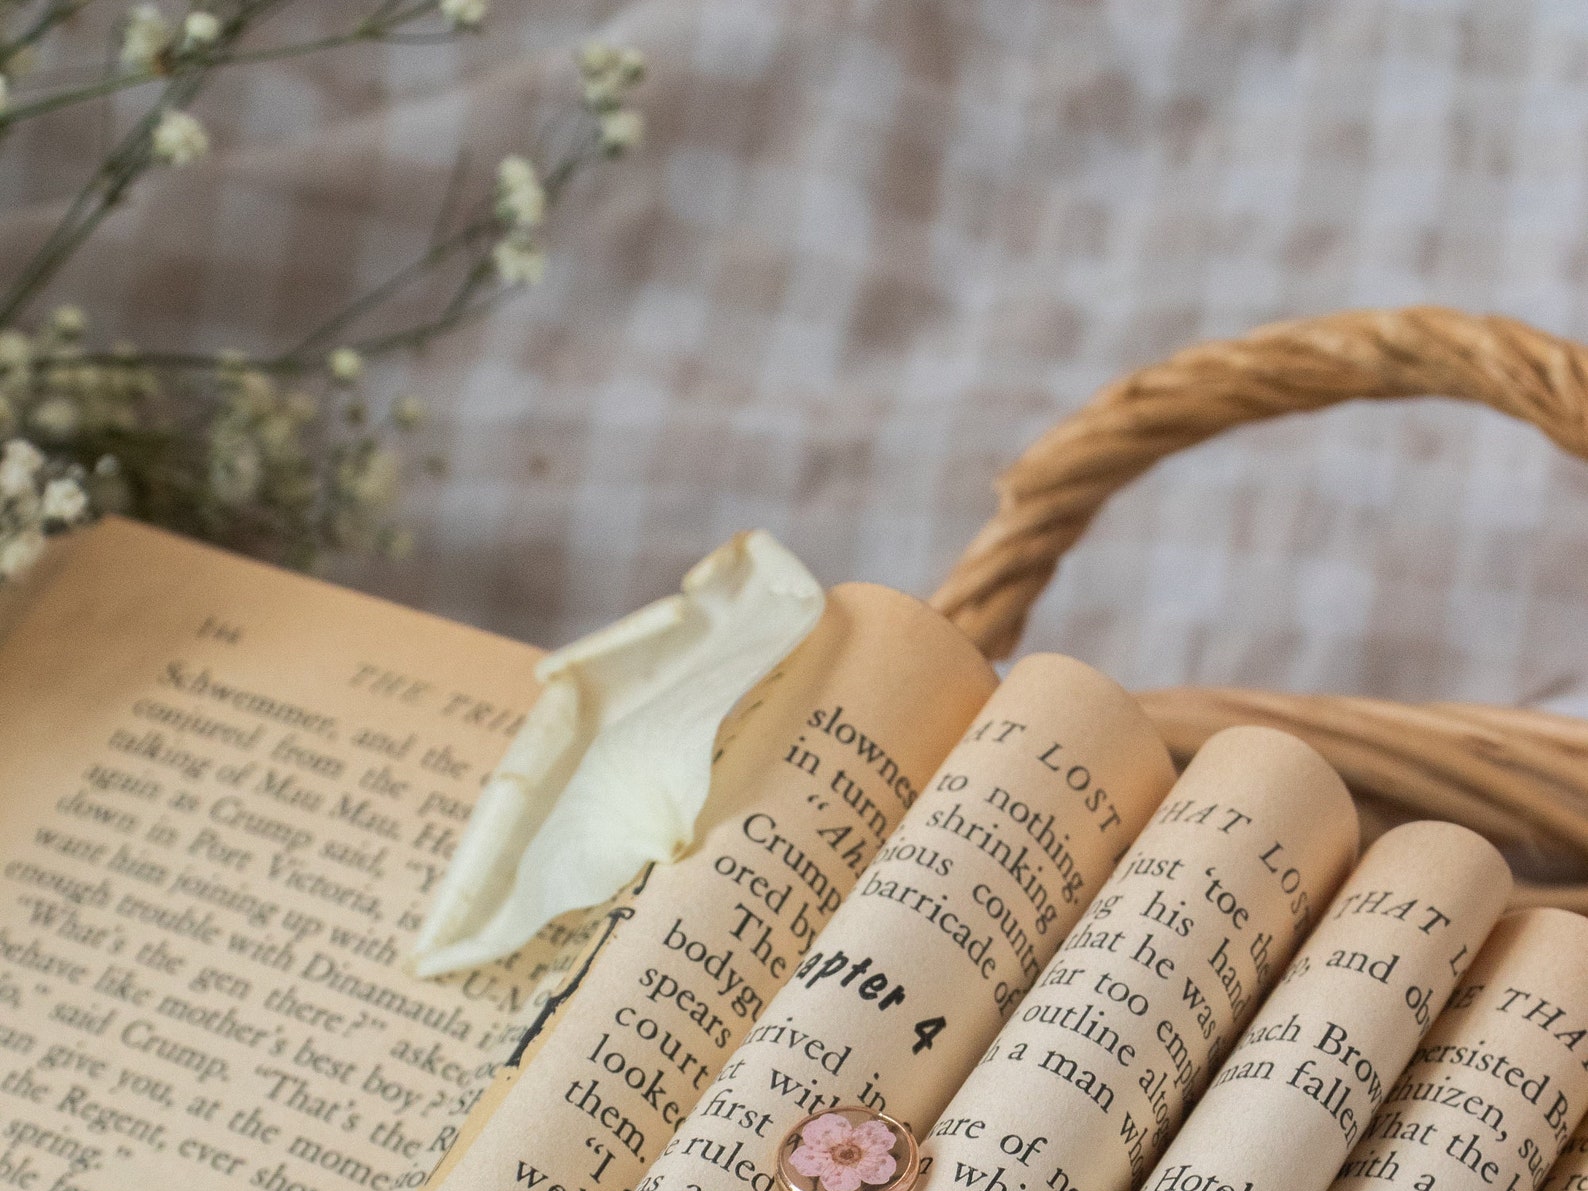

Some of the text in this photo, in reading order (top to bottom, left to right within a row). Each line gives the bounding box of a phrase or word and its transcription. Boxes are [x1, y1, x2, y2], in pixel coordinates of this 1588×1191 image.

[784, 736, 821, 776] in
[1037, 742, 1122, 832] LOST
[714, 856, 793, 915] ored
[743, 813, 841, 914] Crump
[926, 803, 1058, 935] shrinking
[116, 895, 221, 944] trouble
[861, 873, 996, 980] barricade
[1139, 891, 1194, 937] his
[1334, 891, 1450, 935] THAT
[729, 903, 787, 979] The
[1129, 934, 1175, 980] he
[1325, 948, 1400, 984] and
[639, 967, 731, 1048] spears
[1093, 972, 1149, 1016] too
[50, 1002, 117, 1036] said
[912, 1016, 947, 1055] 4
[1022, 1002, 1136, 1067] outline
[615, 1006, 709, 1090] court
[1008, 1042, 1115, 1114] a man
[227, 1105, 280, 1145] the
[700, 1089, 774, 1138] first
[178, 1138, 245, 1176] ever
[1000, 1133, 1048, 1167] of
[1446, 1134, 1499, 1184] the
